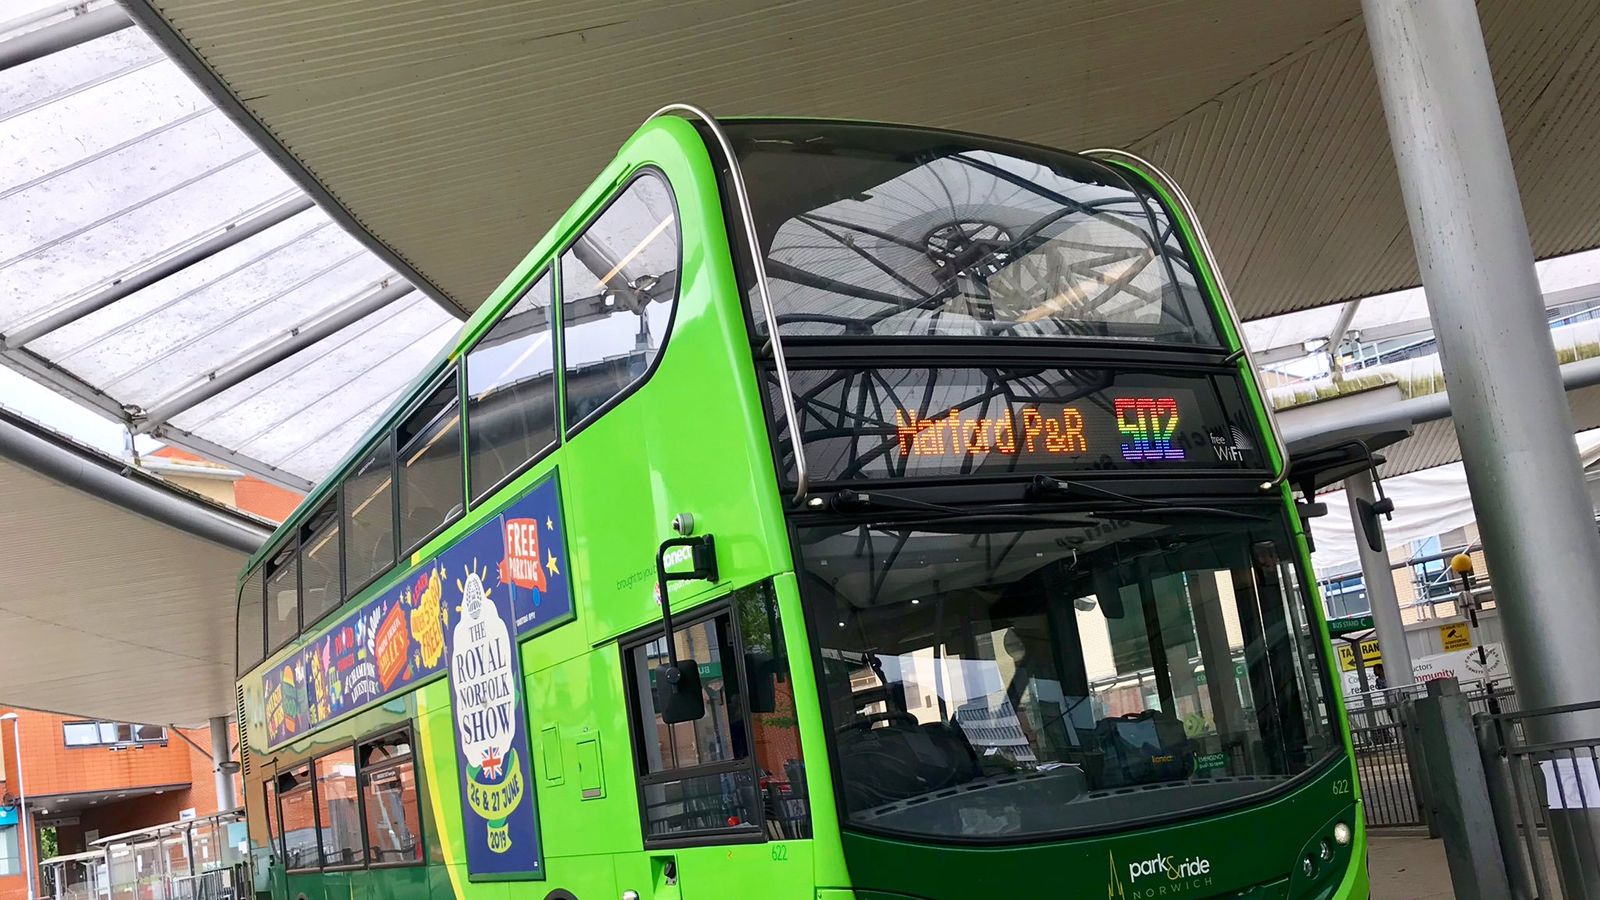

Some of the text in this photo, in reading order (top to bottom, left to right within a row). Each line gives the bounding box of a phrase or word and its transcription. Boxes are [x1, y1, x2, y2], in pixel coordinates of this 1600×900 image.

[896, 407, 1087, 455] Harford P&R
[1113, 397, 1185, 460] 502
[1209, 432, 1226, 445] free
[1213, 445, 1244, 462] WiFi
[507, 522, 536, 557] FREE
[508, 557, 539, 582] PARKING
[469, 620, 487, 644] THE
[1360, 618, 1367, 627] C
[1361, 641, 1380, 655] RAN
[456, 637, 507, 685] ROYAL
[1414, 668, 1455, 684] mmunity
[459, 671, 511, 713] NORFOLK
[462, 702, 512, 745] SHOW
[470, 775, 521, 813] 26 & 27 JUNE
[1332, 779, 1349, 796] 622
[489, 829, 507, 852] 2019
[771, 844, 788, 861] 622
[1132, 876, 1213, 900] NORWICH
